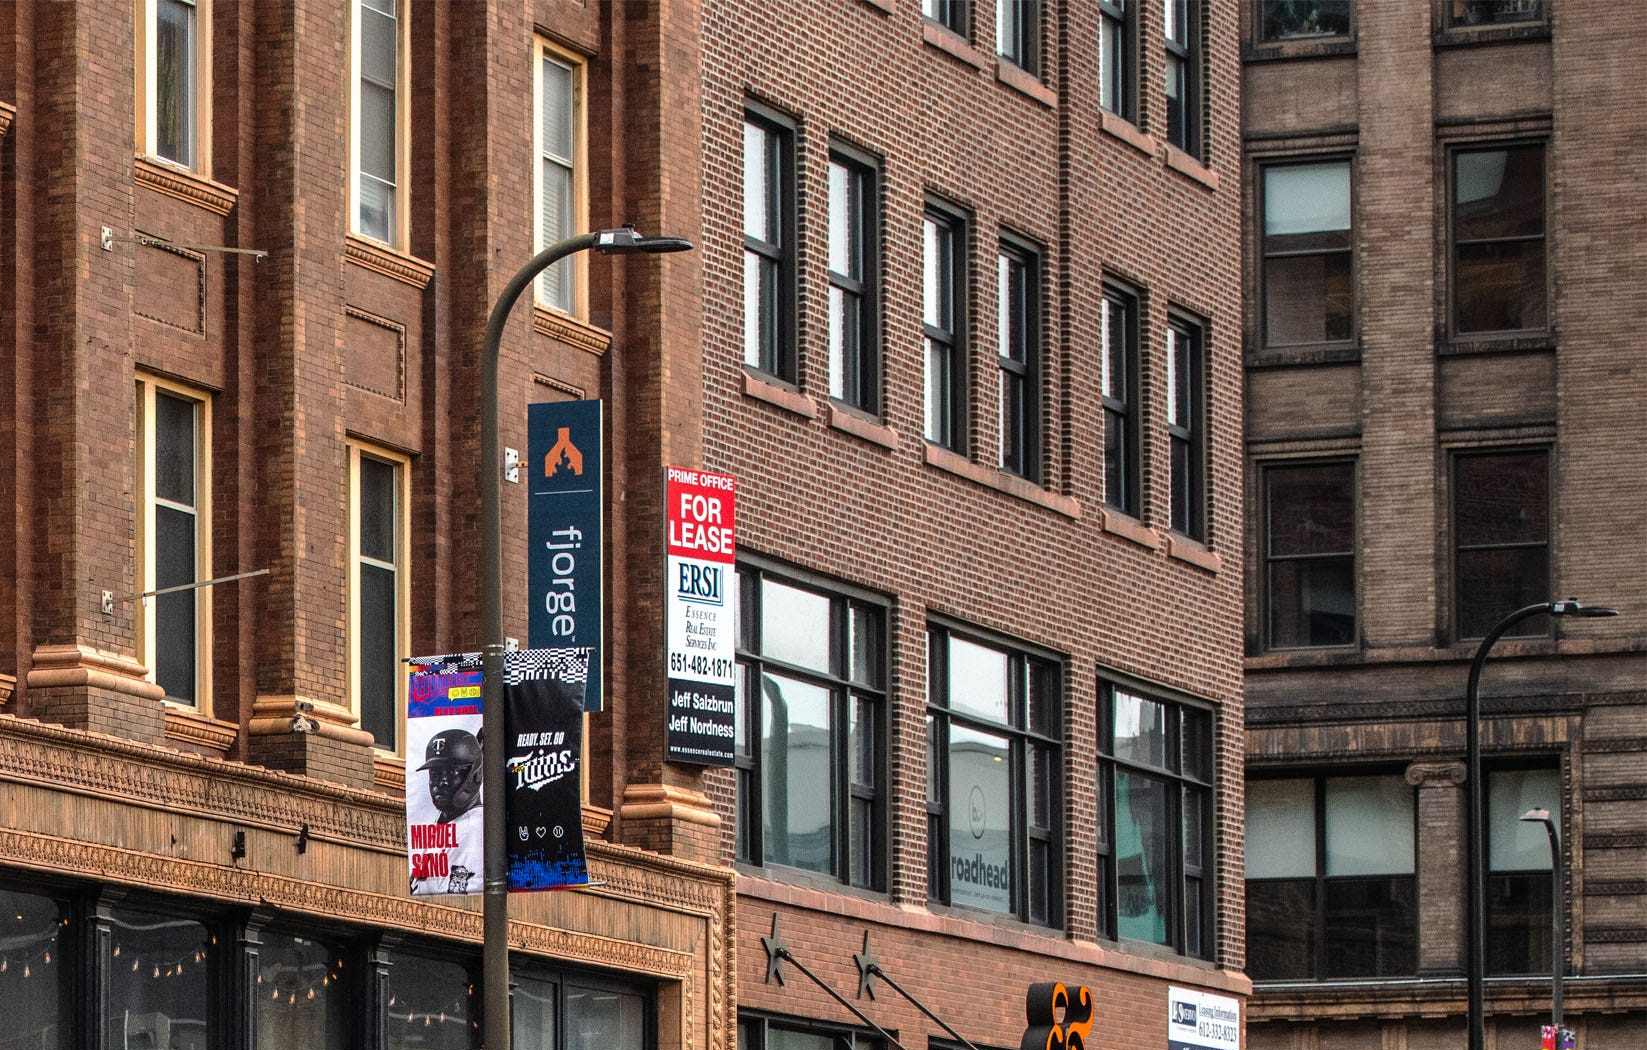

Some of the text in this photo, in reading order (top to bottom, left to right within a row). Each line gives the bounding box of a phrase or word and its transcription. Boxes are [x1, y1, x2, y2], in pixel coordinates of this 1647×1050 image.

[668, 468, 734, 491] PRIME OFFICE
[680, 492, 722, 525] FOR
[669, 520, 733, 555] LEASE
[546, 525, 583, 636] fjorge
[678, 562, 719, 599] ERSI
[670, 652, 733, 679] 651-482-1871
[671, 690, 734, 714] Jeff Salzbrun
[516, 732, 538, 748] READY.
[553, 731, 565, 746] GO
[668, 714, 735, 738] Jeff Nordness
[506, 748, 576, 792] Twins
[410, 823, 459, 850] MIGUEL
[411, 849, 450, 879] SANÓ
[951, 853, 1008, 890] roadhead
